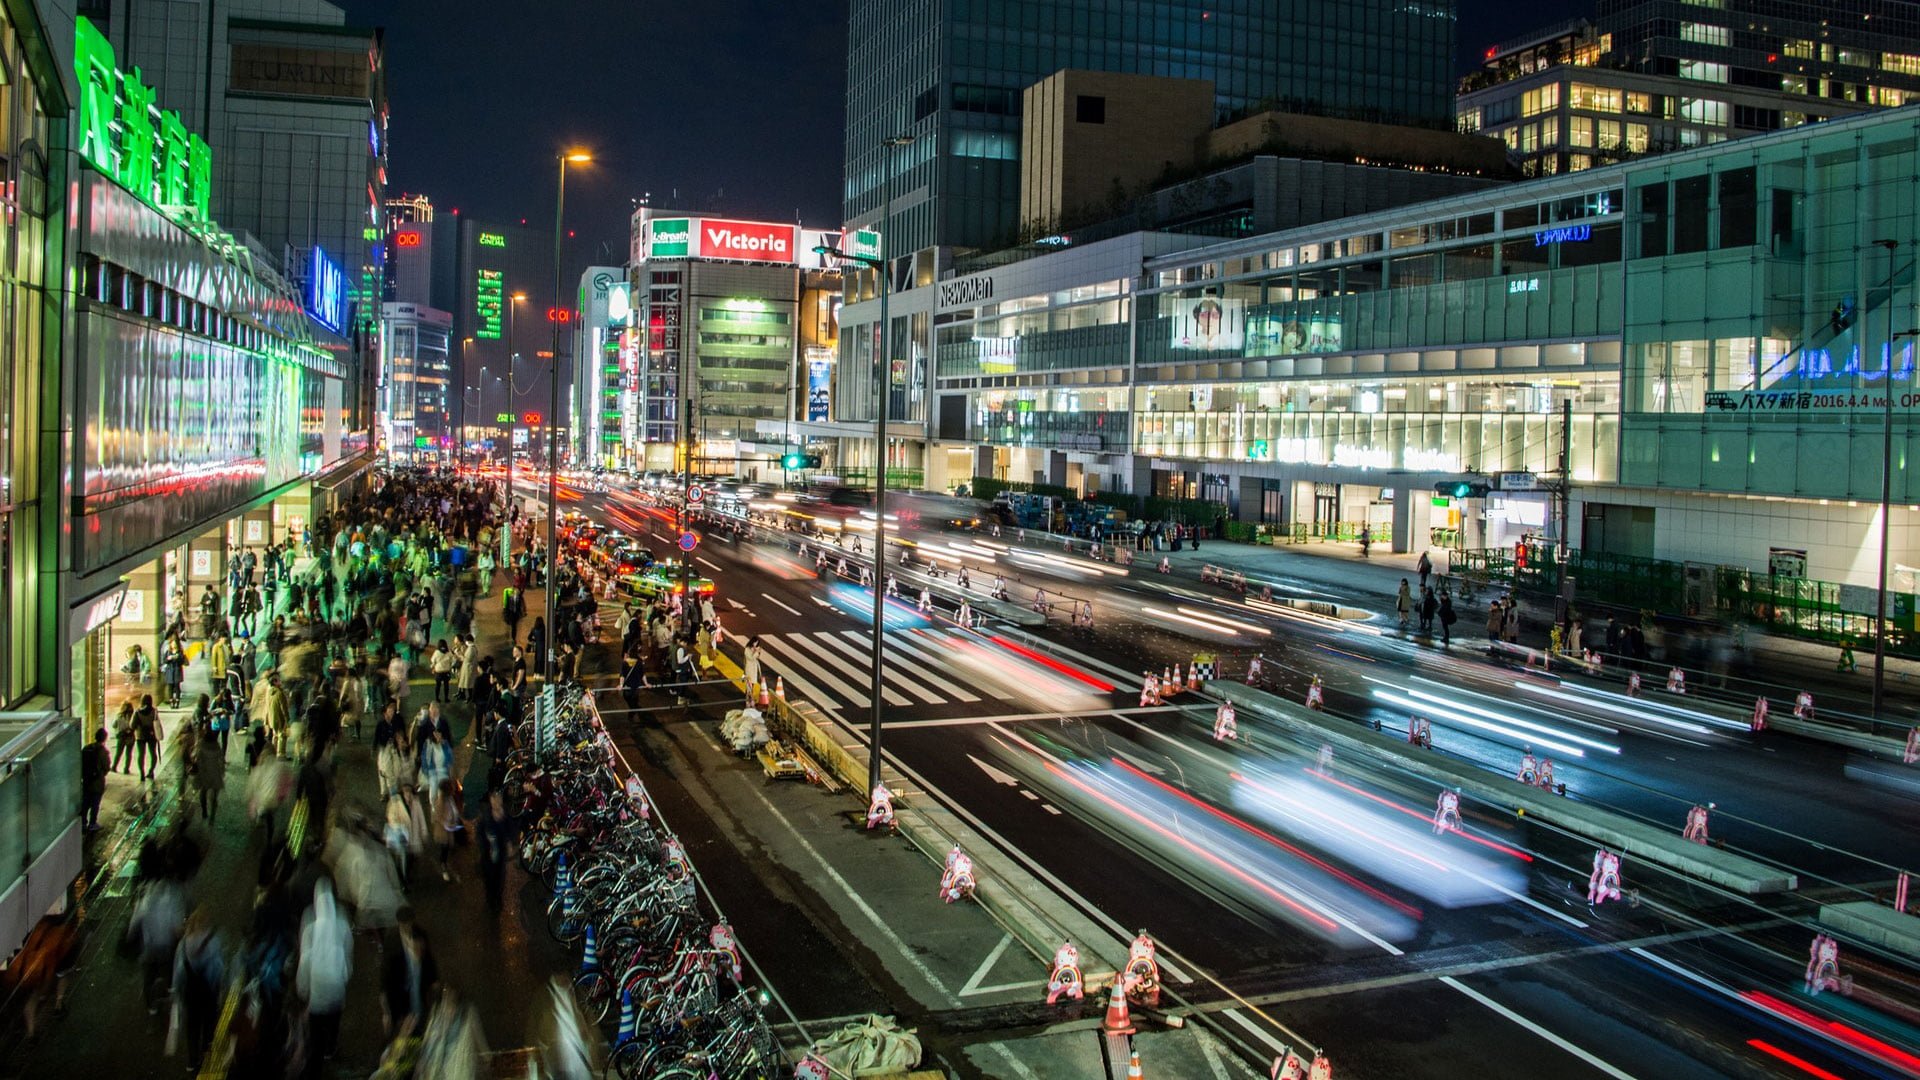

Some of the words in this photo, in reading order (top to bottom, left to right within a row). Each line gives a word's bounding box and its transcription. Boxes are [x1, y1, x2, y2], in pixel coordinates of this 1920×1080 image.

[707, 228, 786, 252] Victoria
[941, 277, 993, 307] NEWoMan
[1740, 392, 1812, 409] バスタ新宿
[1813, 394, 1869, 408] 2016.4.4
